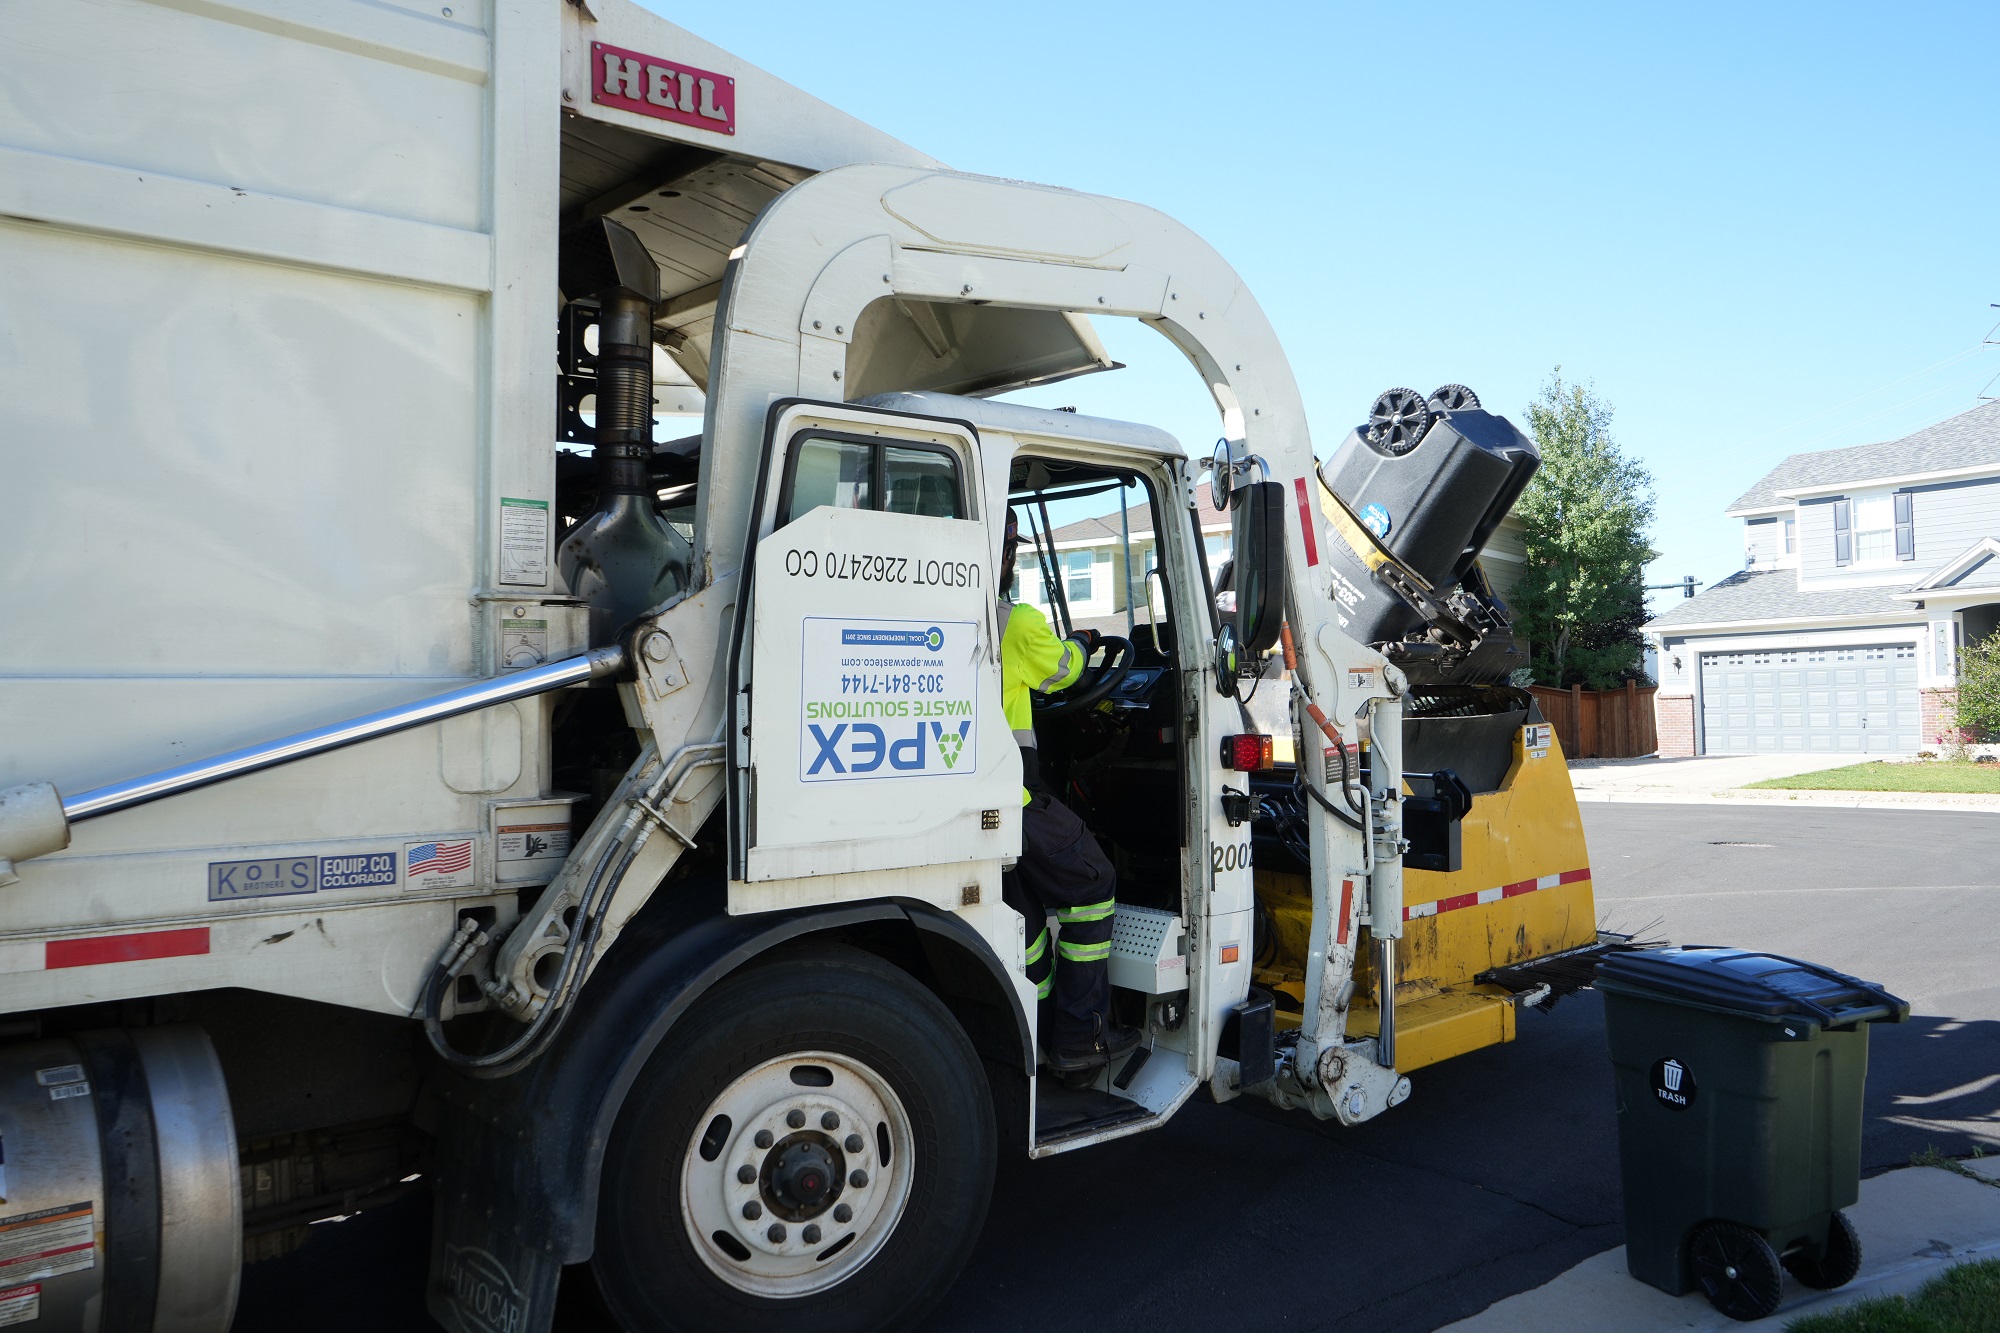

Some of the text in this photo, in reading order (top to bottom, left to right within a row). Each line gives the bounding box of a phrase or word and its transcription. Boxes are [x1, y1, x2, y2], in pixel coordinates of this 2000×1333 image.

[604, 53, 728, 122] HEIL
[786, 549, 980, 588] USDOT 2262470 CO
[857, 633, 872, 641] SINCE
[841, 657, 944, 668] www.apexwasteco.com
[841, 674, 944, 694] 303-841-7144
[806, 700, 973, 719] WASTE SOLUTIONS
[806, 720, 972, 775] APEX
[324, 855, 392, 875] EQUIP. CO.
[243, 880, 285, 891] BROTHERS
[322, 871, 393, 887] COLORADO
[1658, 1089, 1685, 1106] TRASH
[448, 1260, 520, 1333] AUTOCAR
